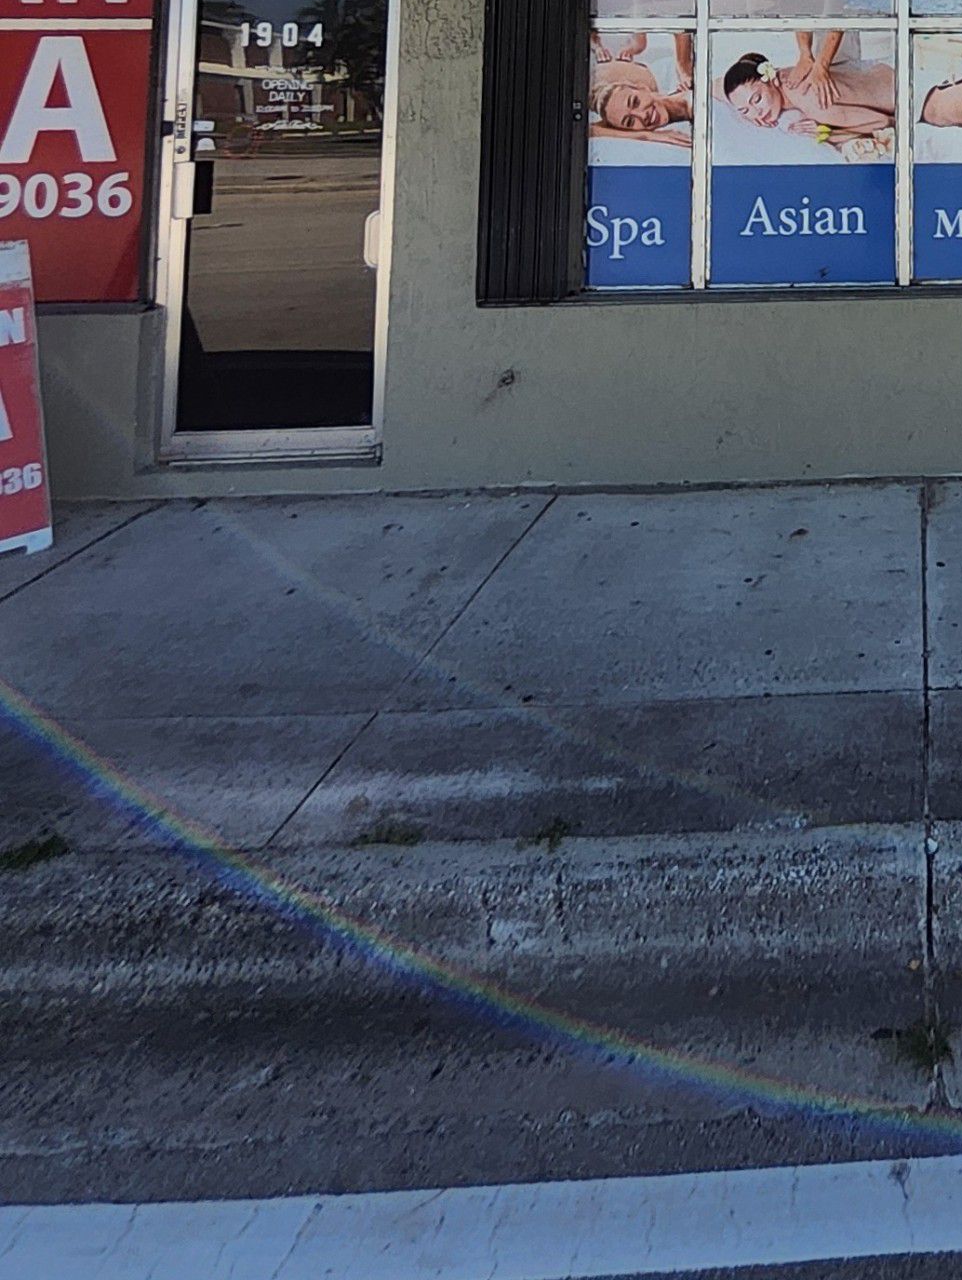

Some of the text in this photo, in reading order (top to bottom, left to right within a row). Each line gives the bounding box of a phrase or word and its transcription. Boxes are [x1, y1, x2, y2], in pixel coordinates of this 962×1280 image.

[241, 22, 323, 47] 1904
[262, 79, 313, 90] OPENING
[269, 91, 306, 102] DAILY
[586, 206, 665, 259] Spa
[740, 197, 867, 236] Asian
